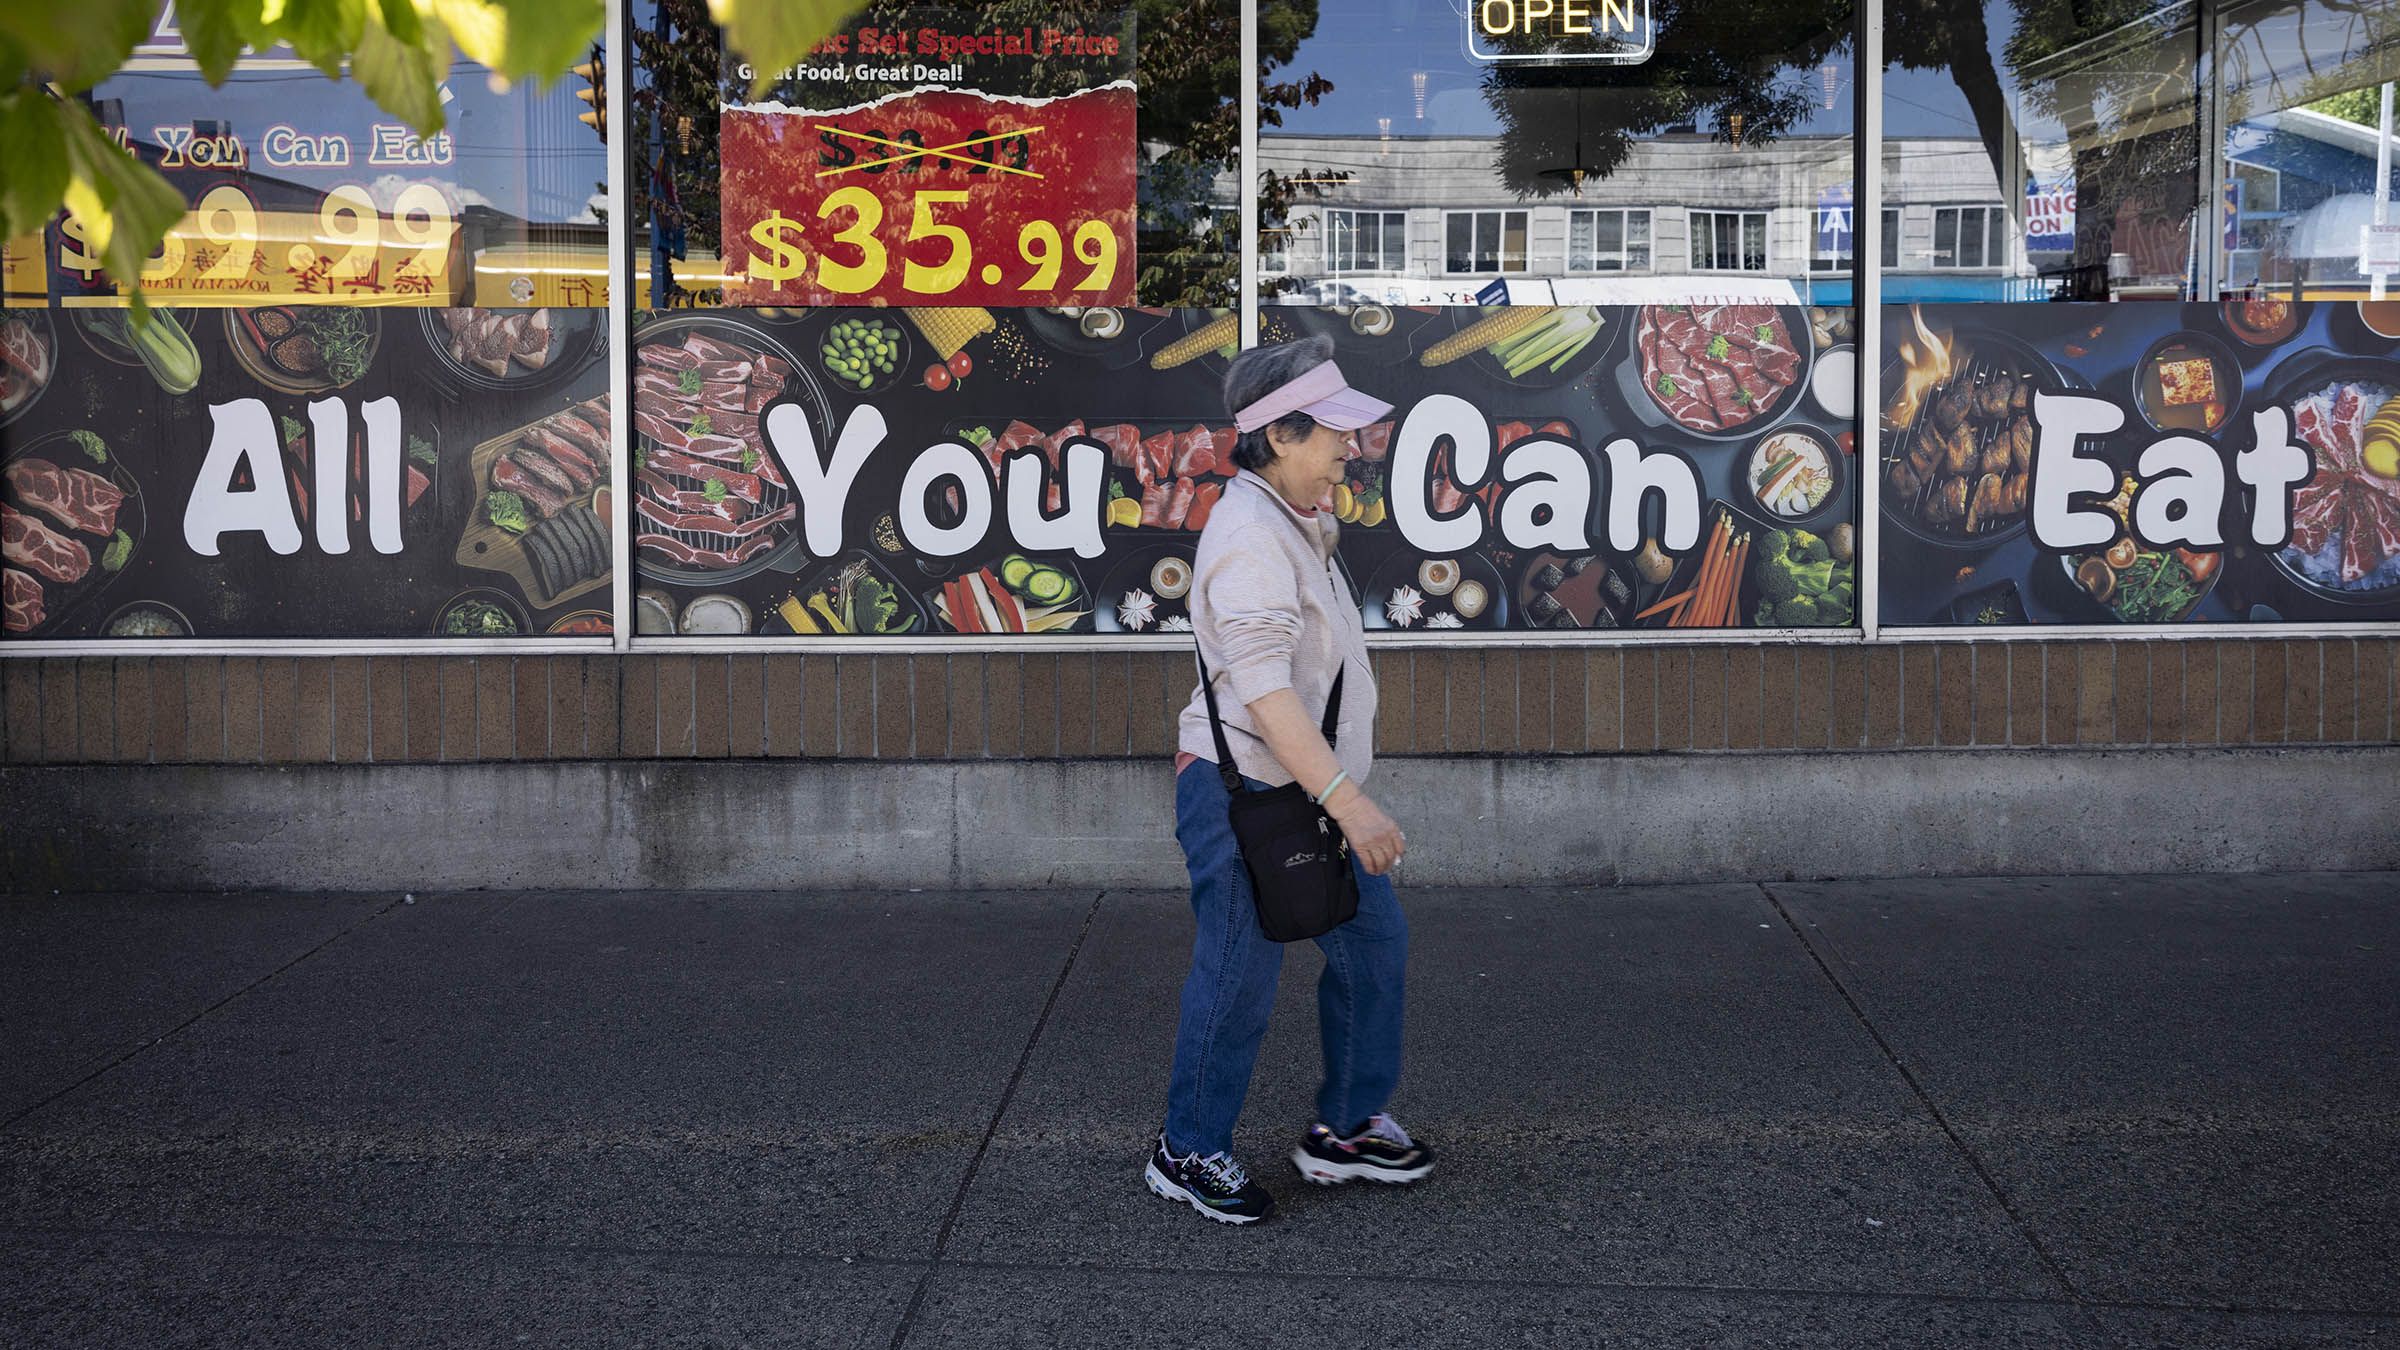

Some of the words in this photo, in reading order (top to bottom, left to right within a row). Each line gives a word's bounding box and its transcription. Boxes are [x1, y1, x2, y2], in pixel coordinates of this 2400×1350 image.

[1482, 0, 1635, 34] OPEN
[858, 27, 909, 55] Set
[917, 27, 1034, 61] Special
[1041, 28, 1119, 56] Price
[797, 62, 850, 83] Food,
[855, 64, 909, 80] Great
[914, 63, 963, 81] Deal!
[154, 127, 244, 167] You
[262, 125, 351, 167] Can
[368, 124, 455, 166] Eat
[817, 123, 1029, 174] $39.99
[748, 186, 1118, 293] $35.99
[183, 396, 405, 556] All
[766, 403, 1107, 559] You
[1390, 394, 1701, 553] Can
[2033, 389, 2310, 548] Eat
